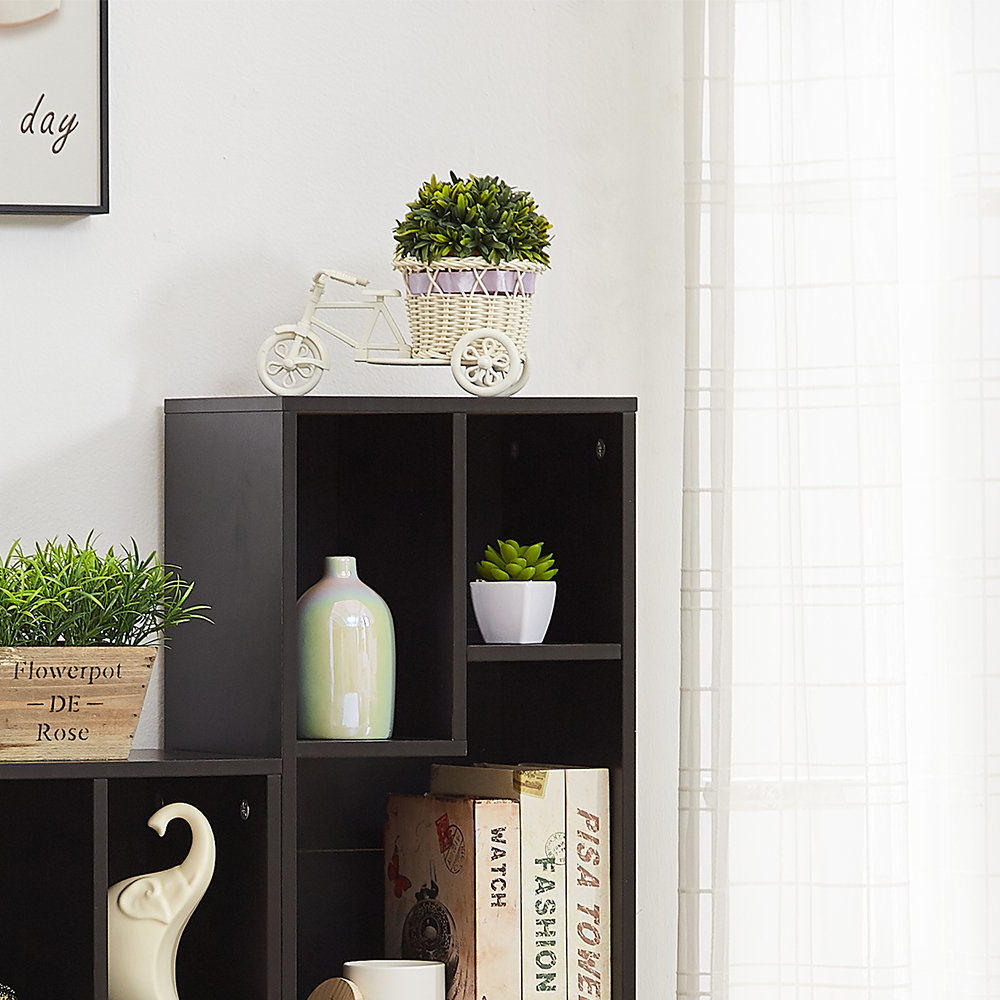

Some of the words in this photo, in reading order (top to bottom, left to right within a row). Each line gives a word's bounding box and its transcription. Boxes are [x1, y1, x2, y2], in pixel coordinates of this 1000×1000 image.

[19, 93, 80, 154] day
[13, 660, 123, 684] Flowerpot
[36, 723, 90, 742] Rose
[49, 694, 82, 713] DE
[490, 826, 507, 908] WATCH
[576, 808, 600, 888] PISA
[535, 857, 557, 992] FASHION
